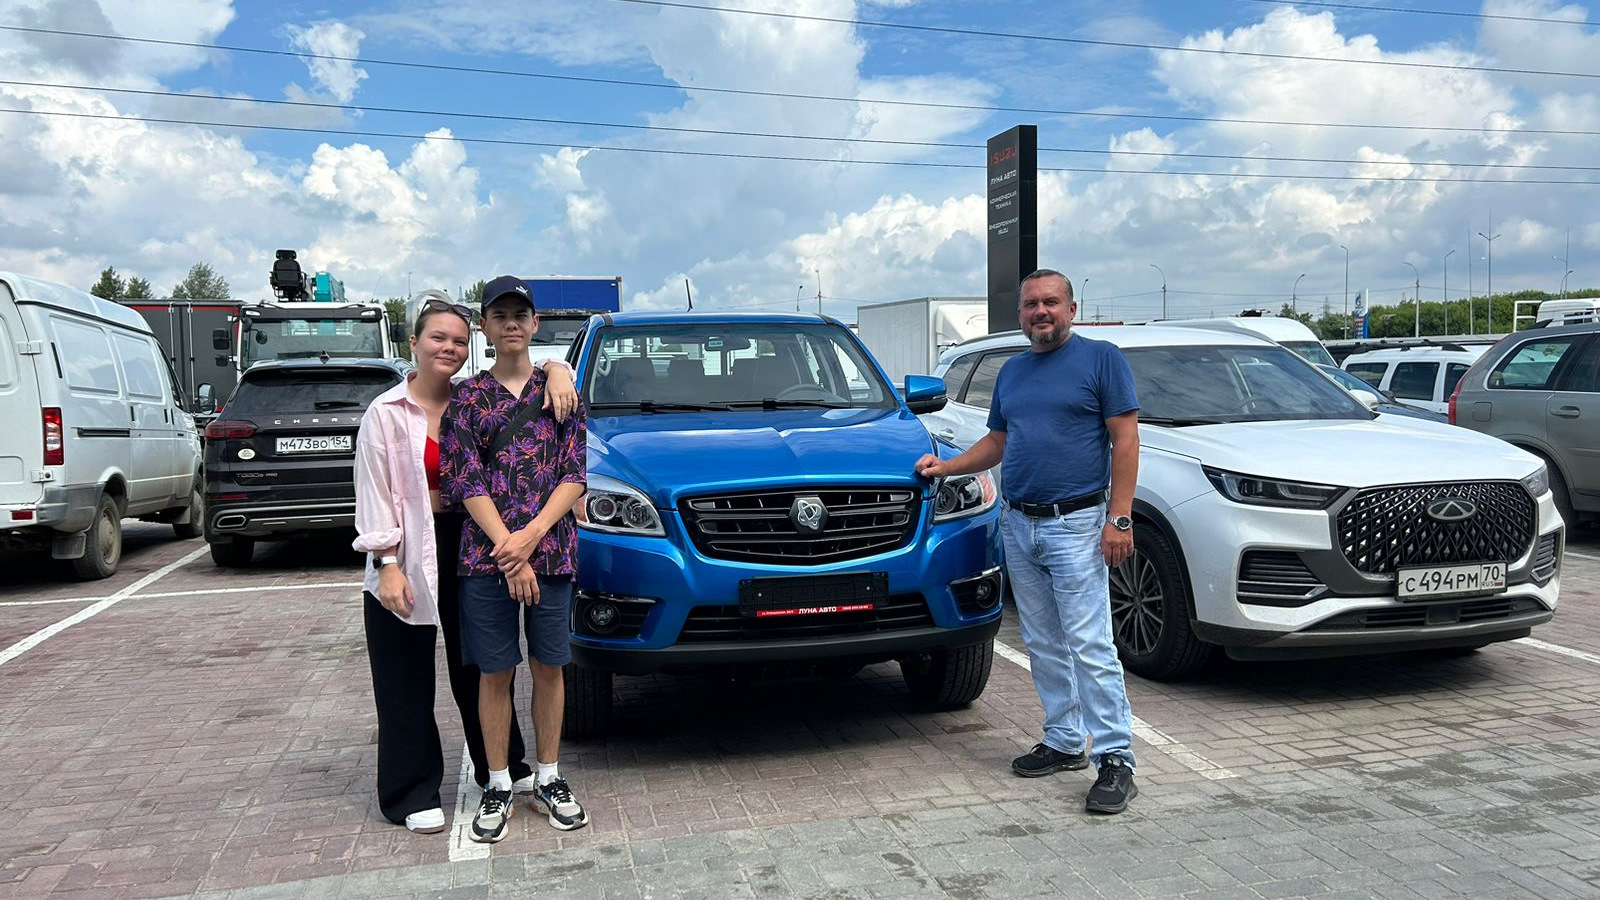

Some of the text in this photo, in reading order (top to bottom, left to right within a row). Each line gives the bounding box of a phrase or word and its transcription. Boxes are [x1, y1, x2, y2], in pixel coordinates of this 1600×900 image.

[1004, 169, 1017, 180] АВТО
[274, 416, 358, 425] CHERY
[280, 435, 348, 450] М473ВО 154
[1405, 566, 1499, 592] С494РМ 70
[798, 607, 818, 615] ЛУНА
[818, 606, 837, 614] АВТО
